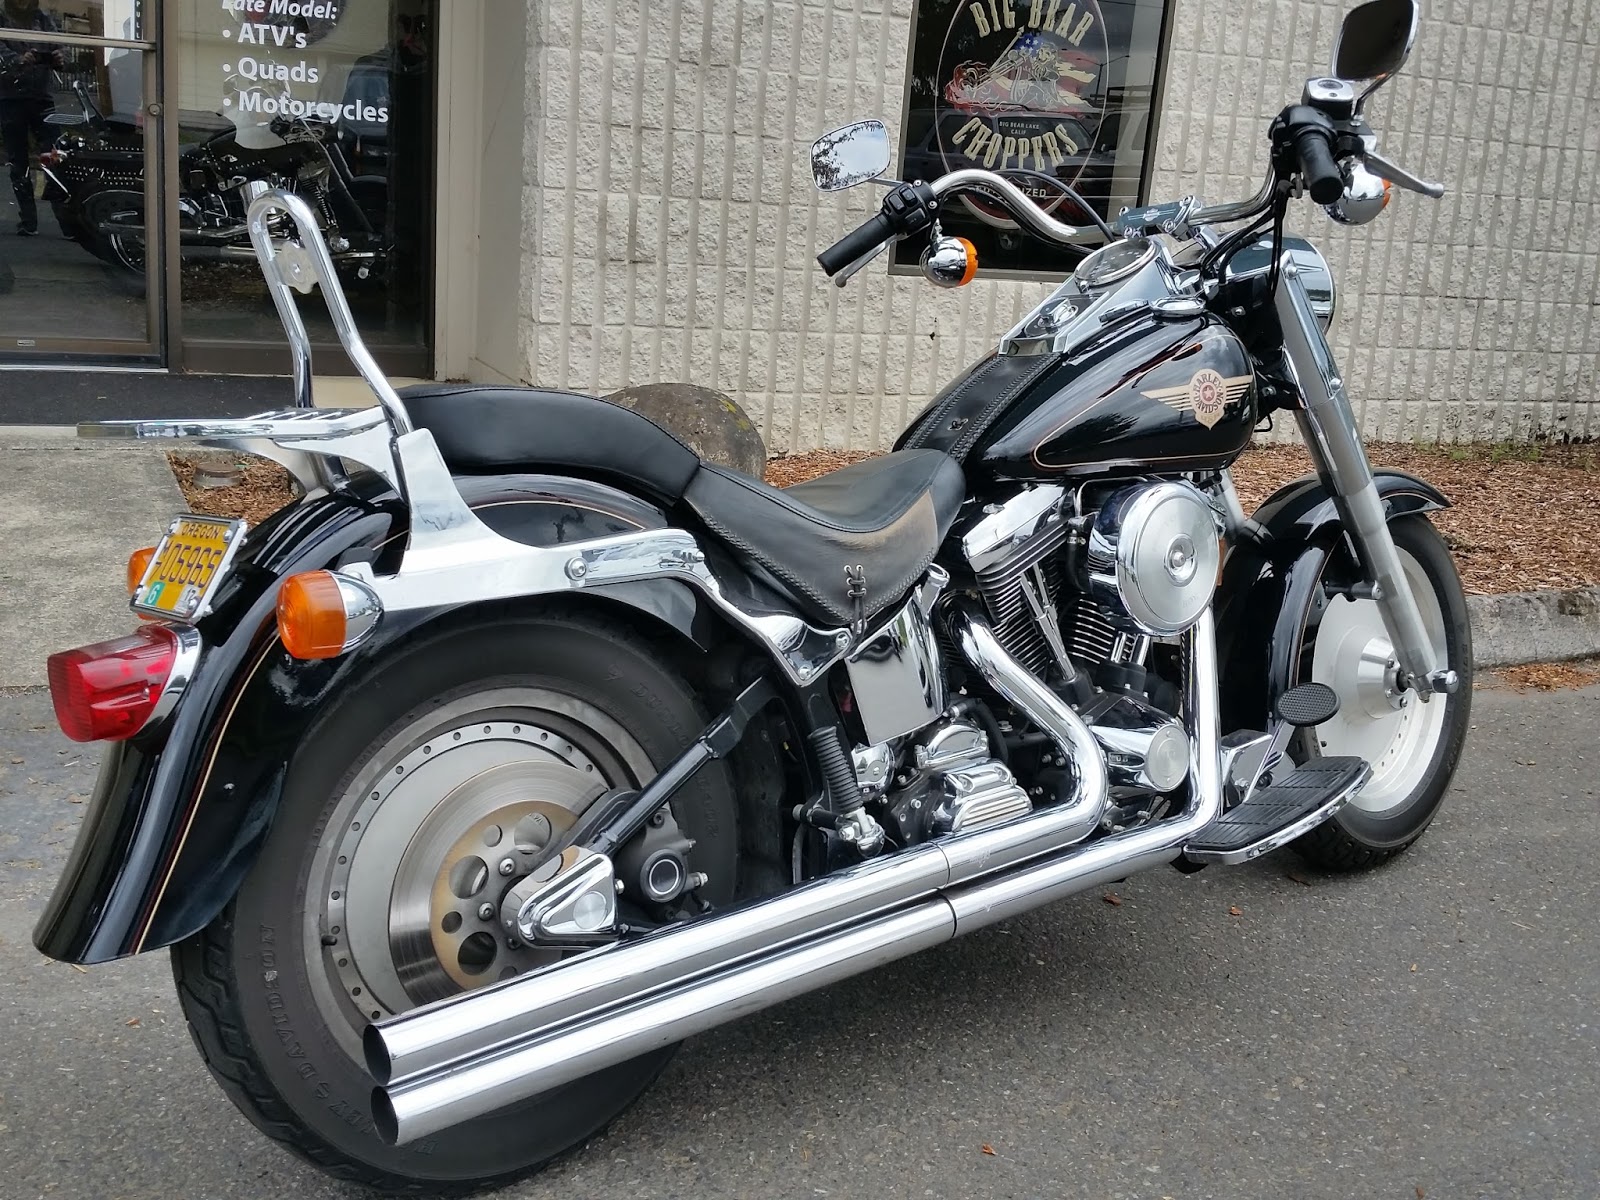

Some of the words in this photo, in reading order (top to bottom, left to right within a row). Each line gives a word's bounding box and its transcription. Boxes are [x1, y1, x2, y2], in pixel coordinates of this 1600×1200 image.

[269, 0, 338, 20] Model:
[238, 23, 307, 49] ATV's
[969, 0, 1016, 38] BIG
[1028, 0, 1094, 47] BEAR
[238, 57, 319, 83] Quads
[239, 91, 389, 124] Motorcycles
[952, 117, 1079, 172] CHOPPERS
[181, 523, 220, 540] OREGON
